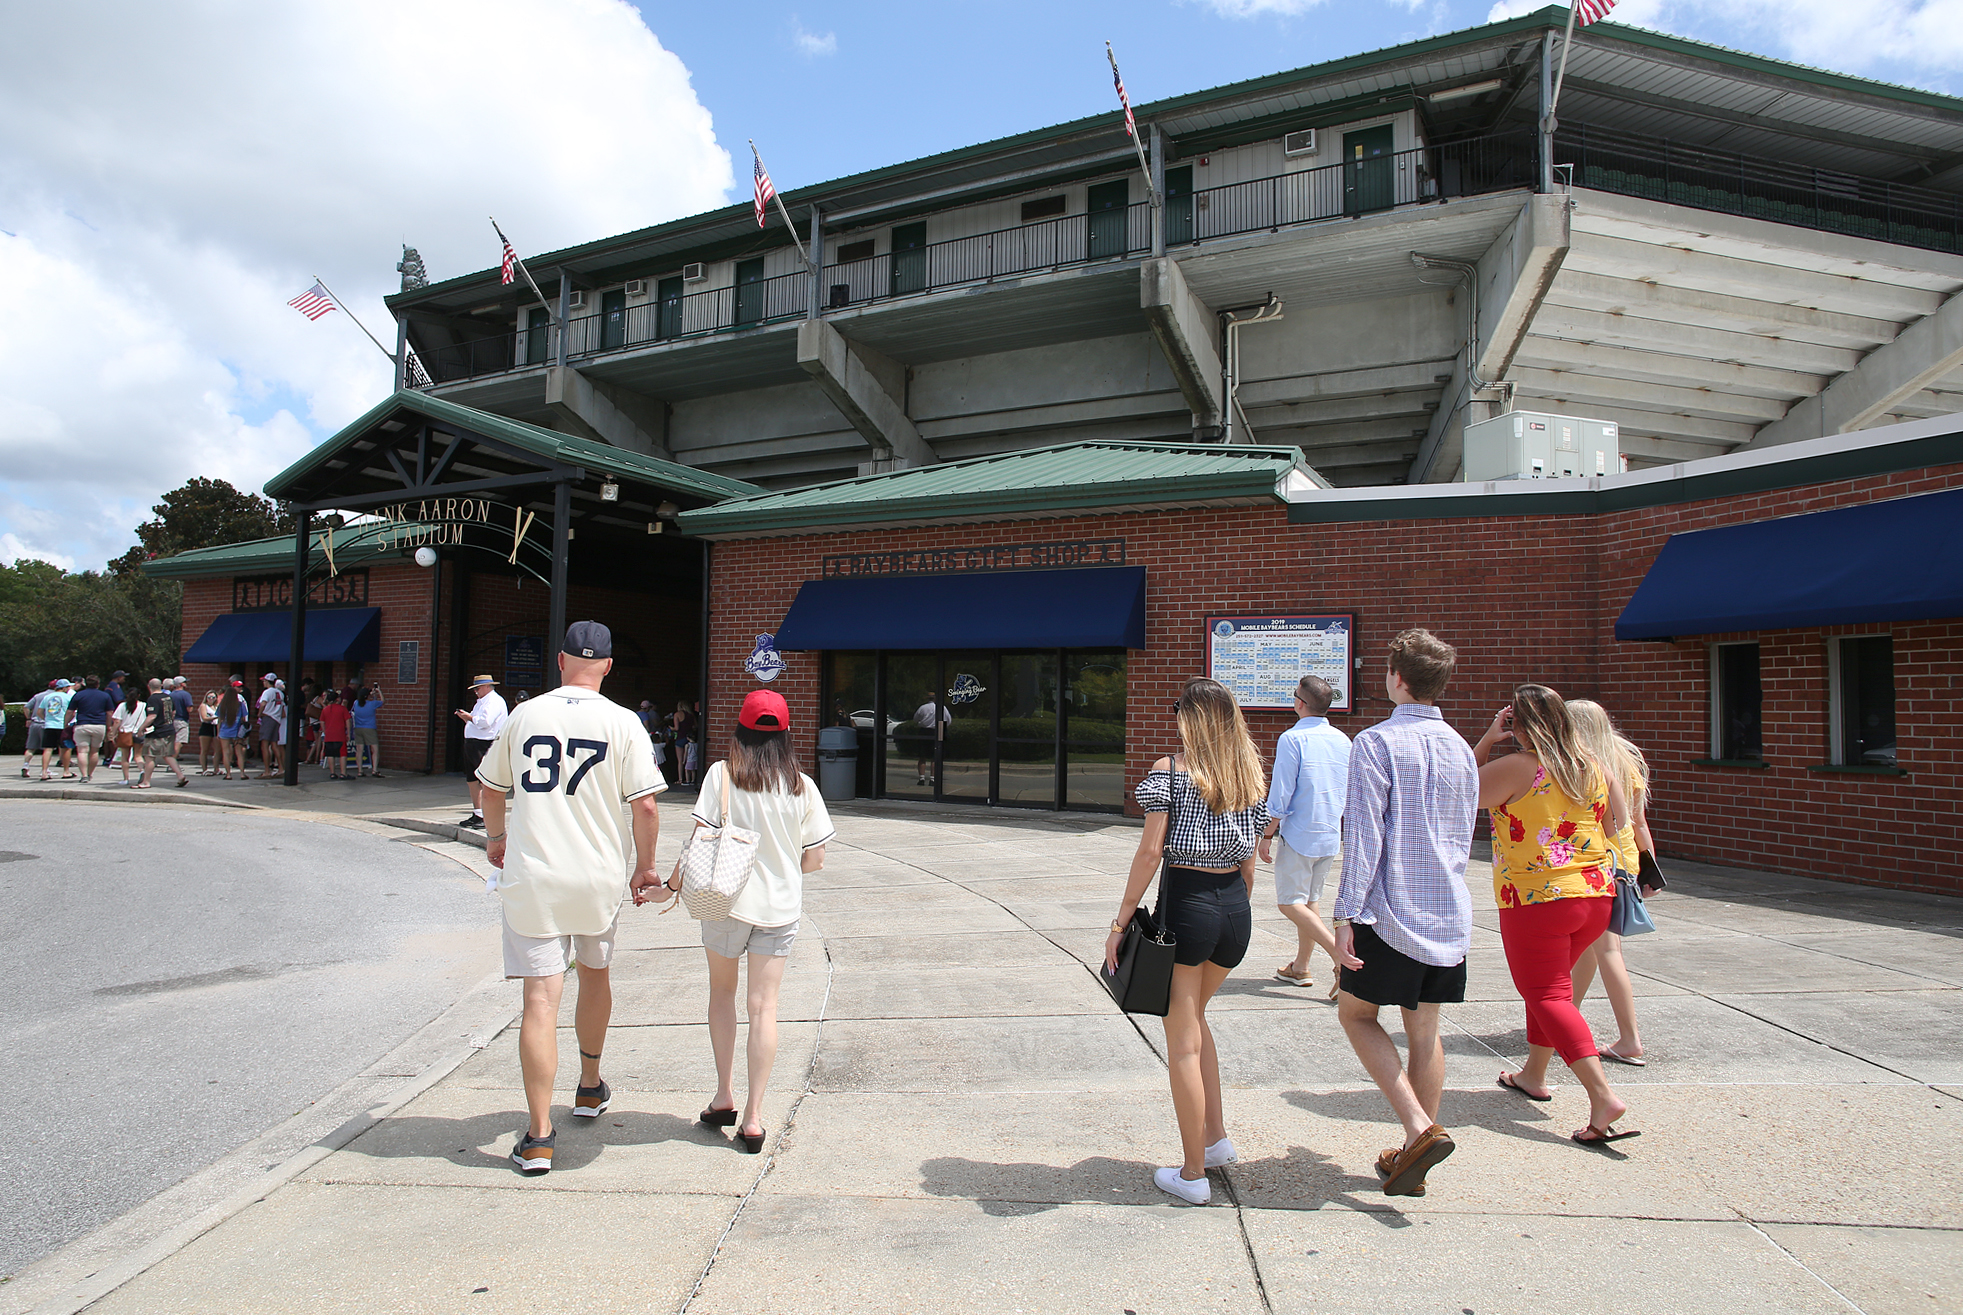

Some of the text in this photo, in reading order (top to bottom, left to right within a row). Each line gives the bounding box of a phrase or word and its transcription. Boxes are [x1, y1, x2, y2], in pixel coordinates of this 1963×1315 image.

[358, 498, 491, 534] HANK AARON
[378, 523, 463, 552] STADIUM
[851, 543, 1090, 575] BAYBEARS GIFT SHOP
[254, 577, 345, 607] TICETS
[521, 735, 609, 797] 37
